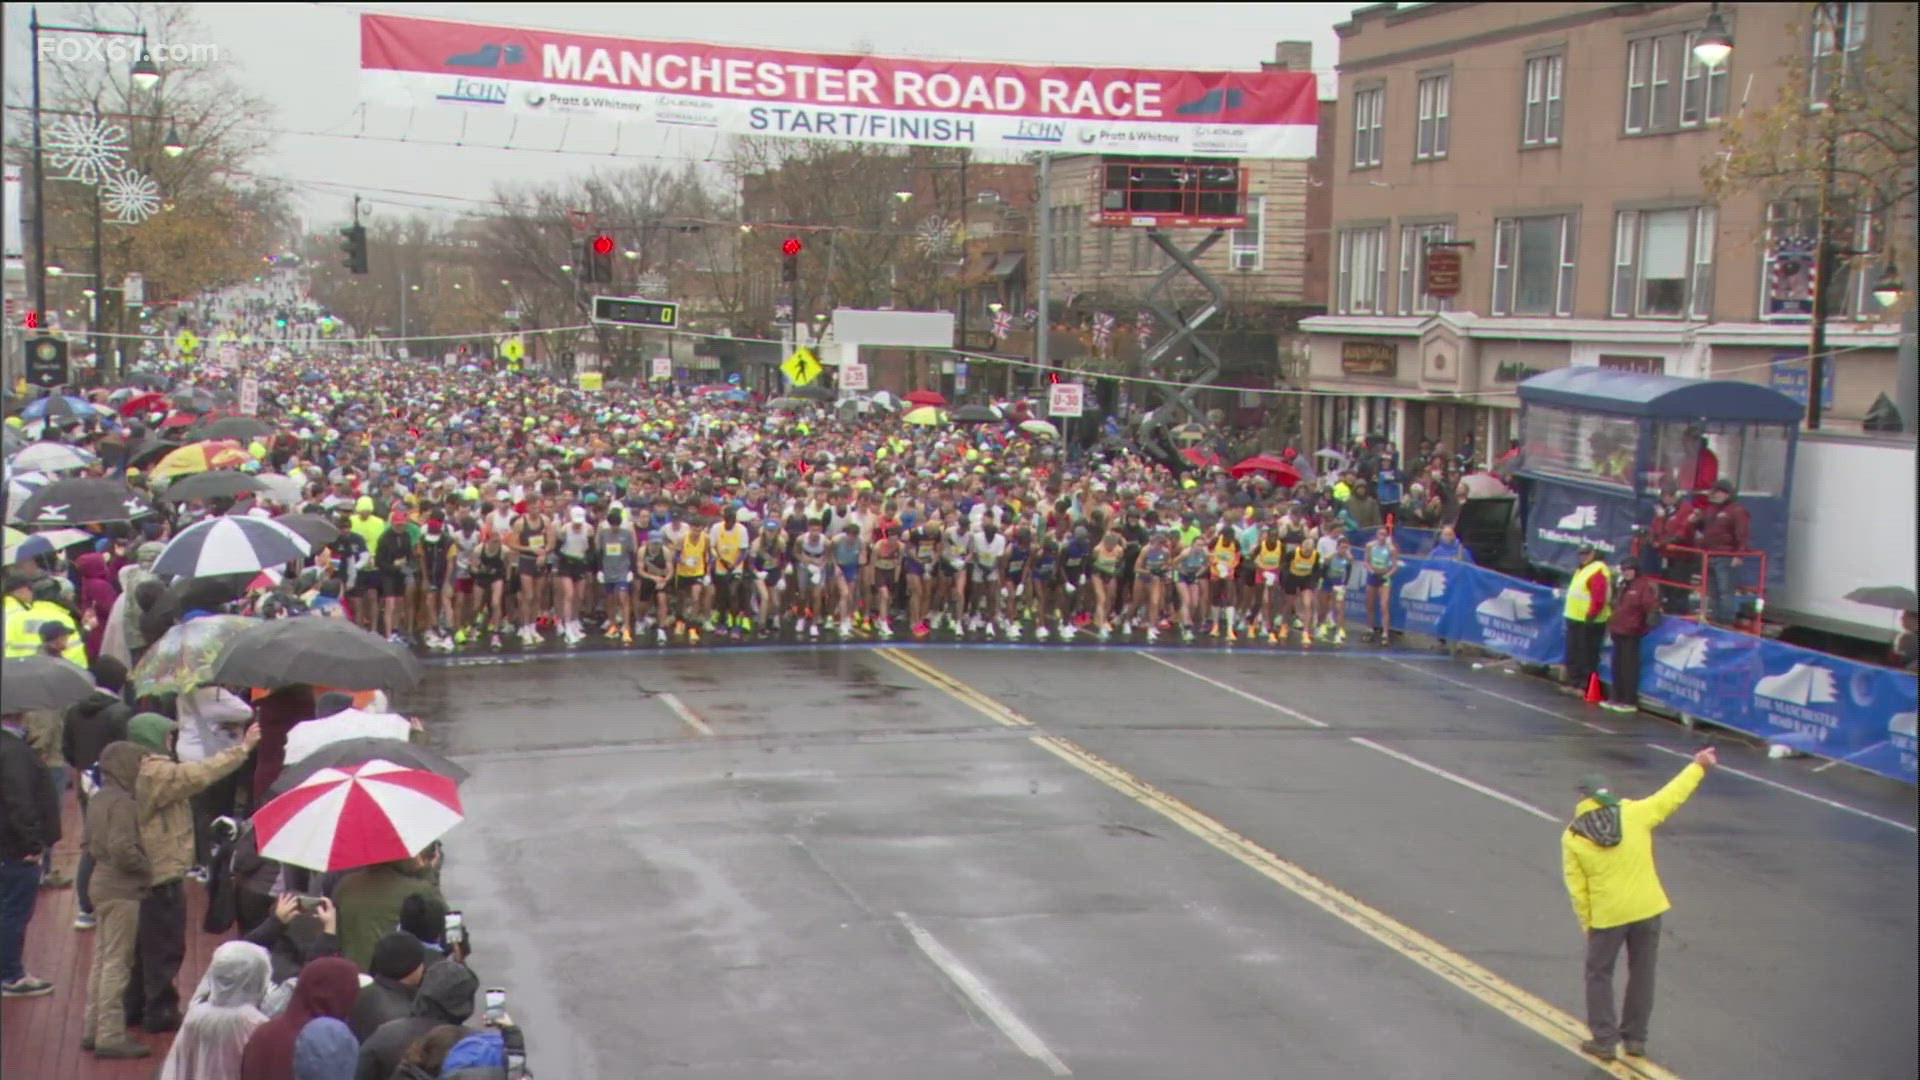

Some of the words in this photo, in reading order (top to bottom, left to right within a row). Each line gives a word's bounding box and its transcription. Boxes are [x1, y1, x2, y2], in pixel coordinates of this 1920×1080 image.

[455, 78, 510, 100] ECHN
[542, 43, 881, 105] MANCHESTER
[894, 71, 1026, 112] ROAD
[1040, 78, 1163, 117] RACE
[549, 93, 581, 106] Pratt
[583, 97, 590, 107] &
[592, 97, 643, 112] Whitney
[749, 106, 976, 142] START/FINISH
[1100, 130, 1126, 141] Pratt
[1128, 132, 1136, 142] &
[1137, 133, 1180, 144] Whitney
[661, 307, 672, 323] 0
